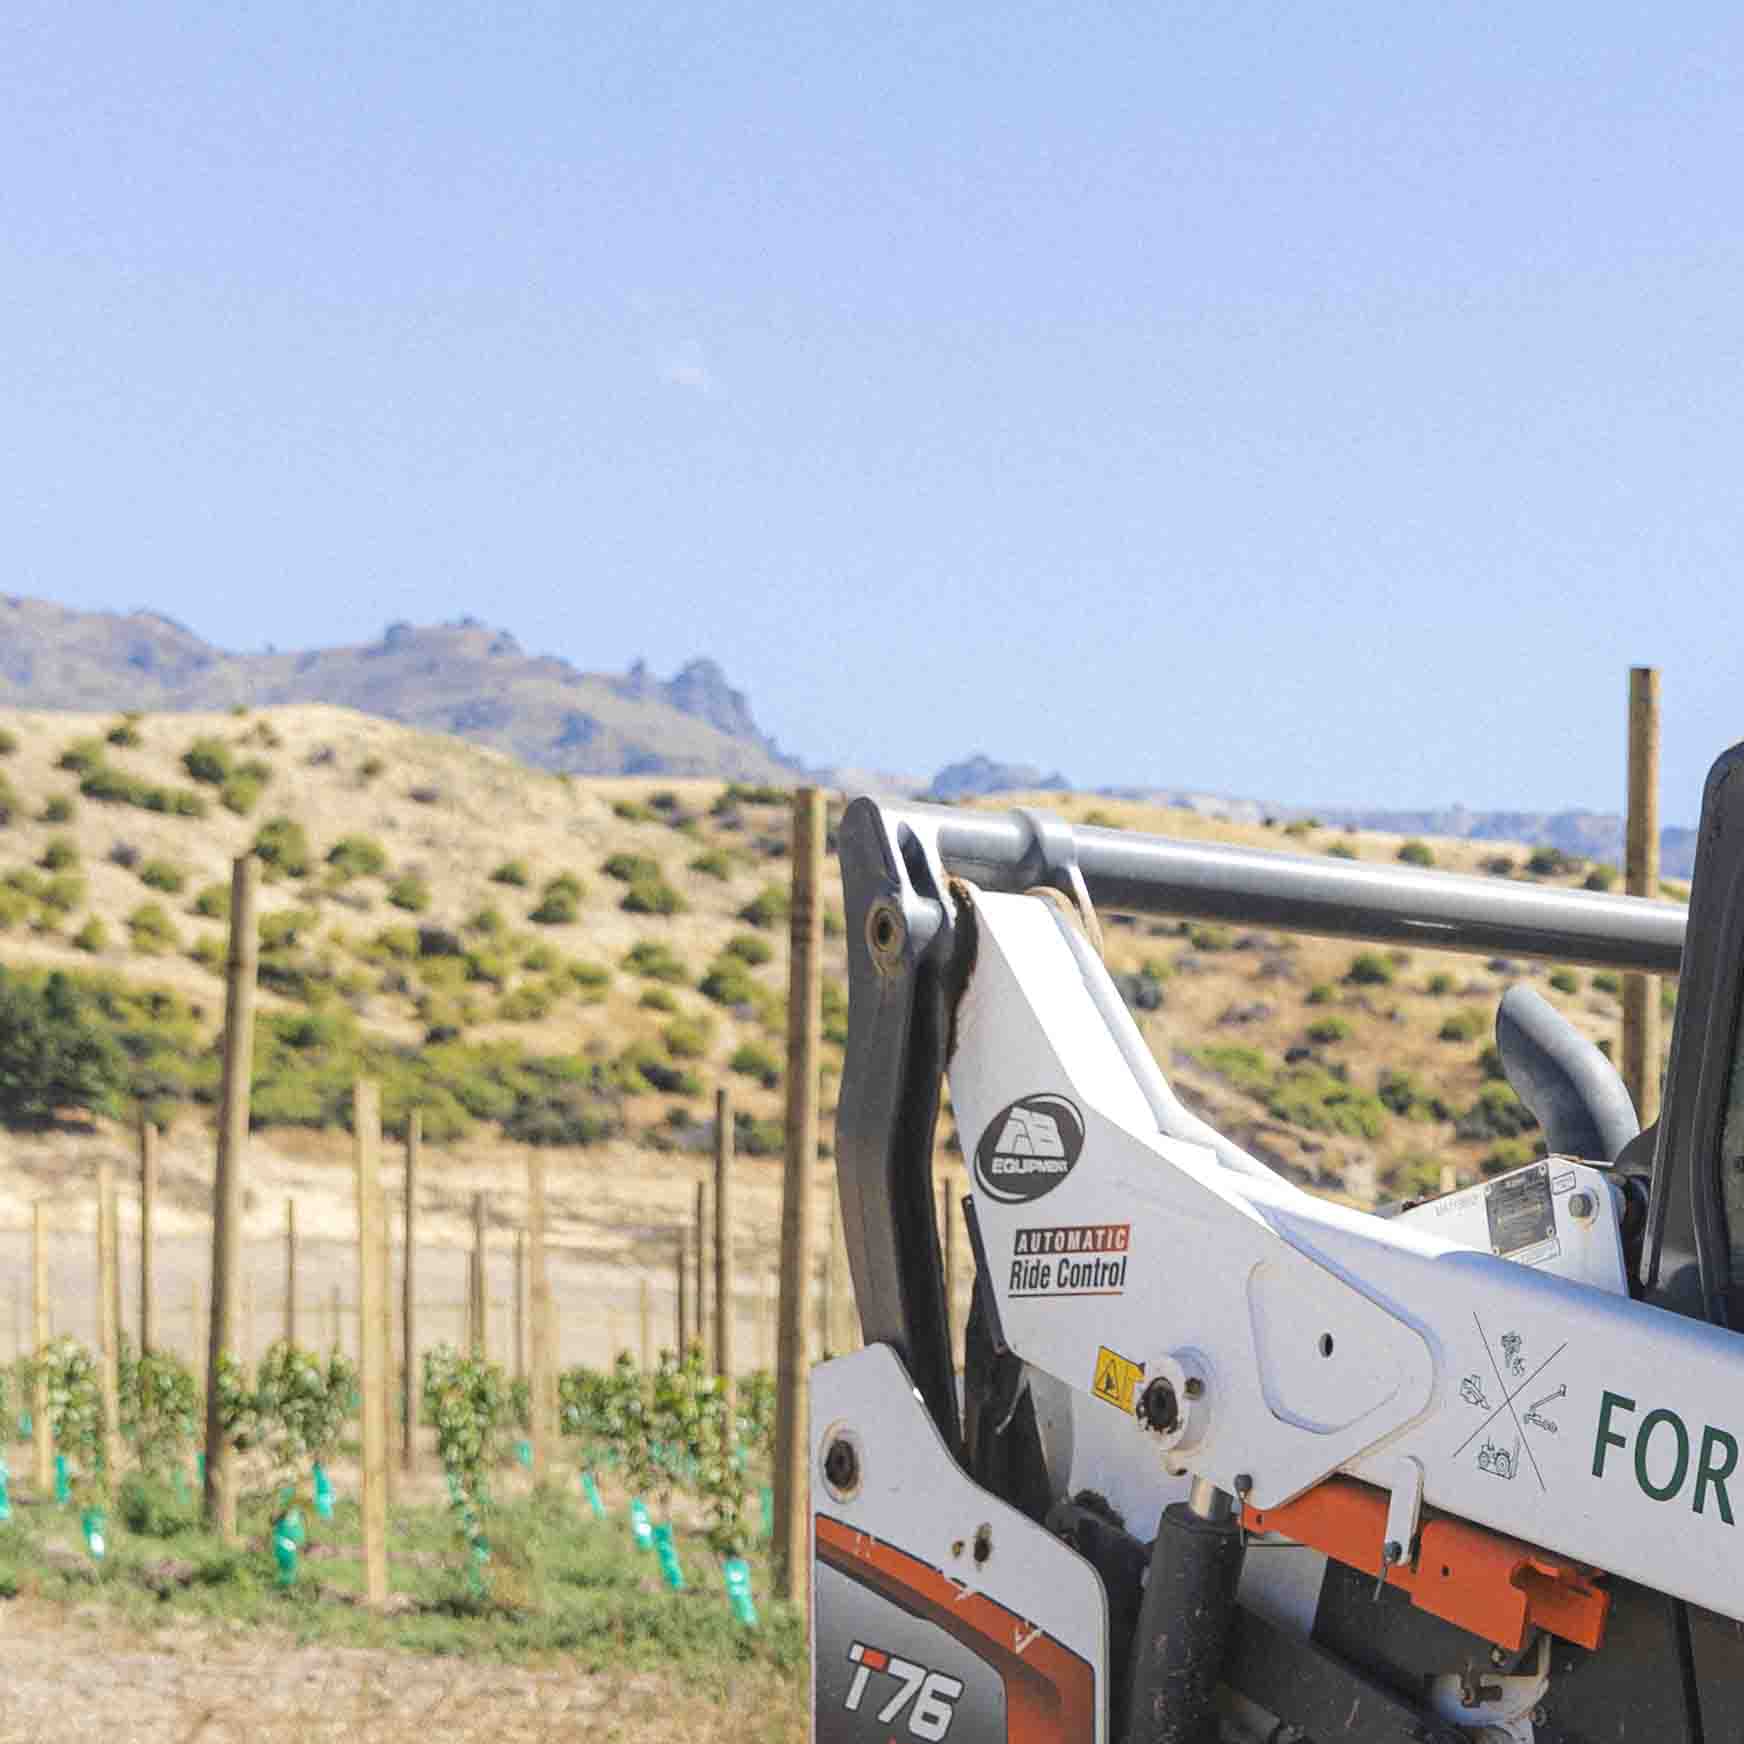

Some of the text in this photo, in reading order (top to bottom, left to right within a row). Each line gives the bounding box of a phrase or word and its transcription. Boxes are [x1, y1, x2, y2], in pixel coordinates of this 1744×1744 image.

[991, 1157, 1069, 1174] EQUIPMENT
[1017, 1228, 1127, 1252] AUTOMATIC
[1008, 1255, 1127, 1290] Ride Control
[844, 1641, 964, 1743] T76
